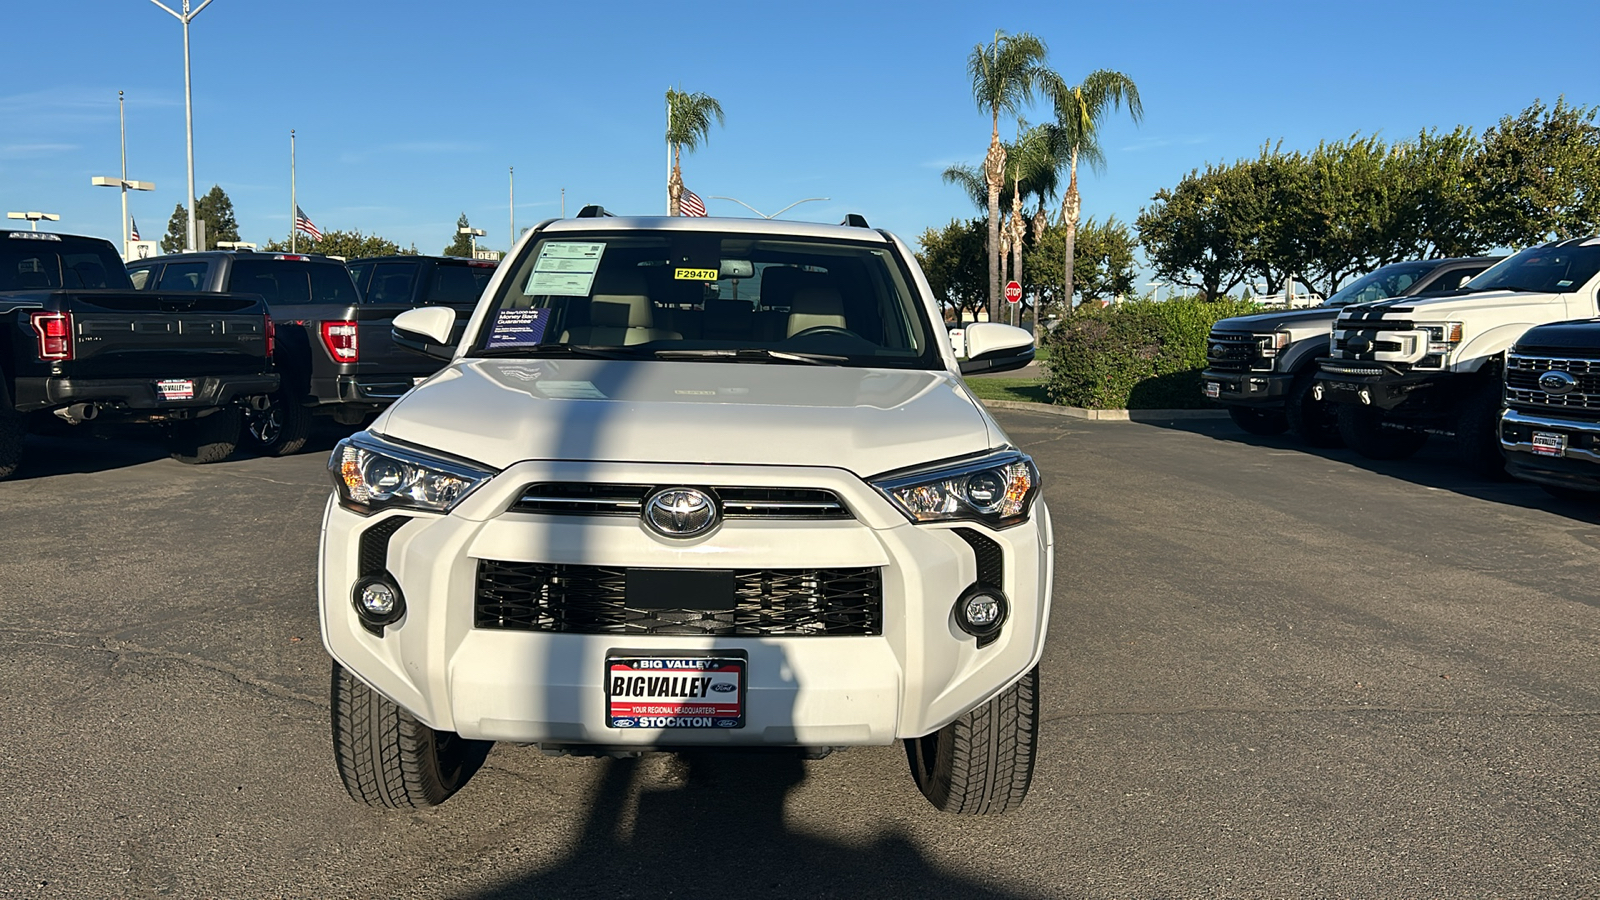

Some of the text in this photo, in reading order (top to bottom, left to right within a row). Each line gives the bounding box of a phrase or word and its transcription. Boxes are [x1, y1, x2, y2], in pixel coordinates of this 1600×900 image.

[676, 270, 715, 279] F29470
[1006, 287, 1021, 297] STOP
[78, 320, 261, 335] FORD
[640, 660, 711, 669] BIG VALLEY
[611, 676, 713, 698] BIGVALLEY
[632, 706, 716, 714] YOUR REGIONAL HEADQUARTERS
[639, 717, 712, 727] STOCKTON
